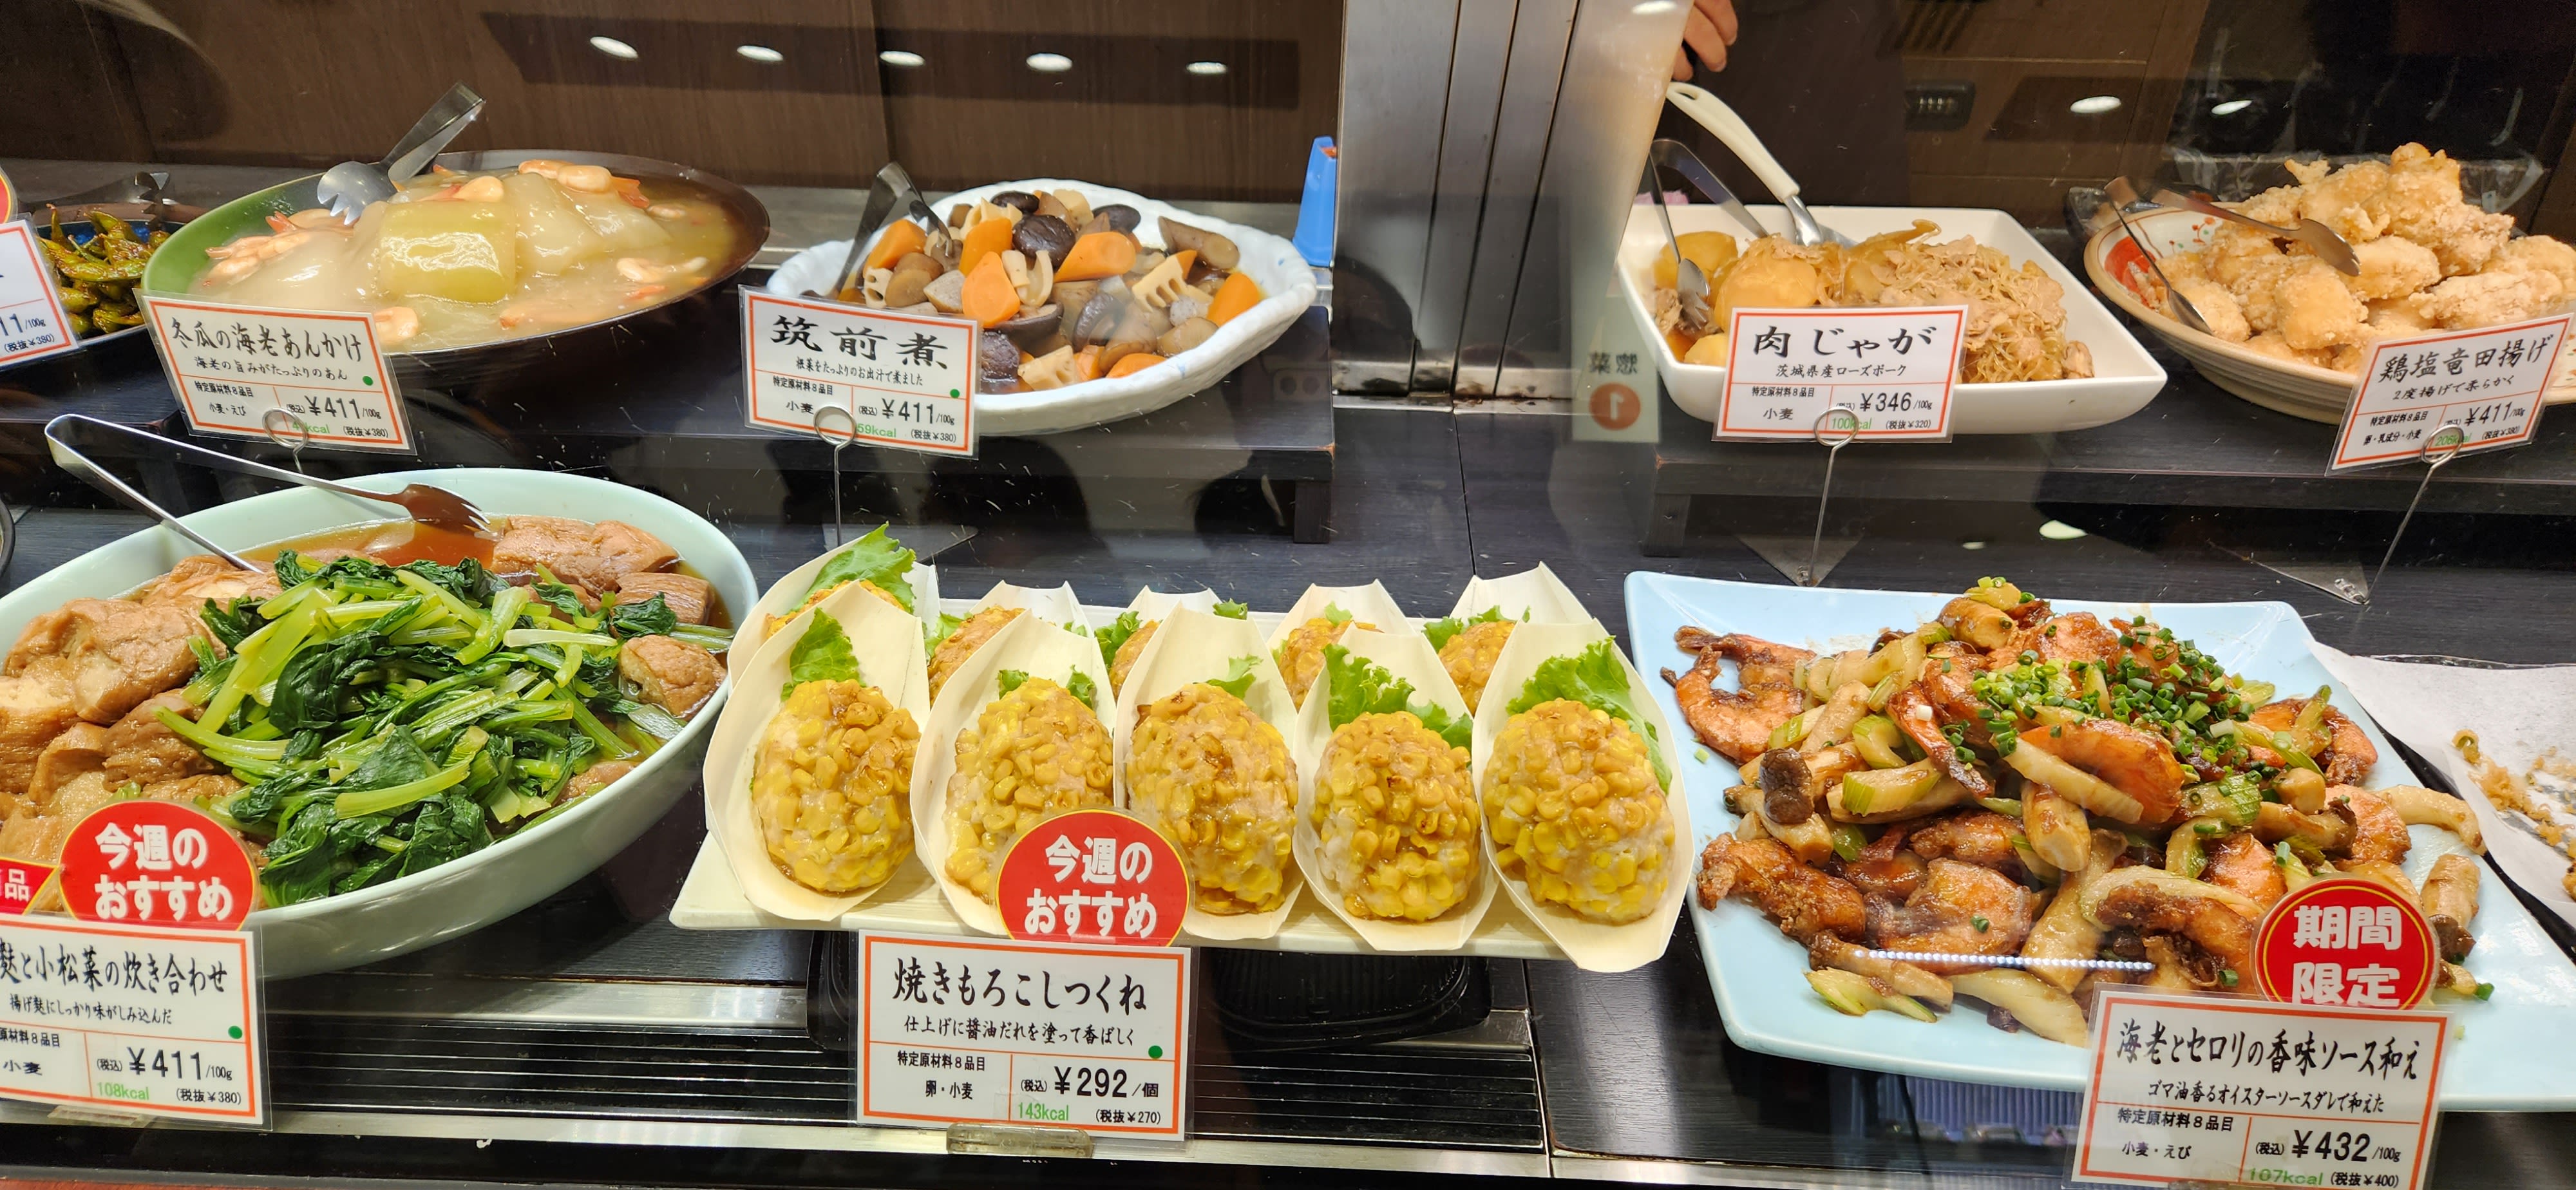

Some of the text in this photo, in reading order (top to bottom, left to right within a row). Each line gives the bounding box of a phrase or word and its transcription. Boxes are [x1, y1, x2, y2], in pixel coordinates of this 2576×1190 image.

[5, 334, 55, 353] (税抜¥380)
[171, 317, 361, 362] 冬瓜の海老あんかけ
[770, 314, 948, 370] 筑前煮
[1753, 325, 1937, 359] 肉じゃが
[194, 356, 347, 381] 海老の旨みがたっぷりのあん
[795, 356, 923, 386] 根菜をたっぷりのお出汁で煮ました
[1776, 363, 1907, 378] 茨城県産ローズポーク
[2378, 334, 2554, 384] 鶏塩竜田揚げ
[773, 375, 833, 395] 特定原材料8品目
[1752, 386, 1815, 397] 特定原材料8品目
[2392, 375, 2514, 401] 2度揚げで柔らかく
[786, 401, 814, 414] 小麦
[1763, 408, 1793, 420] 小麦
[292, 420, 330, 434] 4kcal
[95, 822, 208, 870] 今週の
[1045, 835, 1153, 883] 今週の
[0, 868, 30, 902] 品
[94, 874, 233, 921] おすすめ
[1025, 888, 1157, 939] おすすめ
[2293, 905, 2401, 950] 期間
[893, 956, 1148, 1015] 焼きもろこしつくね
[2292, 962, 2400, 1008] 限定
[904, 1015, 1135, 1046] 仕上げに醤油だれを塗って香ばしく
[897, 1050, 985, 1071] 特定原材料8品目
[2116, 1017, 2420, 1081] 海老とセロリの香味ソース和え
[3, 1060, 43, 1076] 小麦
[97, 1082, 150, 1100] 108kcal
[176, 1087, 242, 1105] (税抜¥380)
[925, 1080, 973, 1100] 卵・小麦
[2148, 1079, 2385, 1114] ゴマ油香るオイスターソースダレで和えた
[1018, 1102, 1070, 1121] 143kcal
[1095, 1108, 1161, 1125] (税抜¥270)
[2117, 1108, 2234, 1131] 特定原材料8品目
[2122, 1141, 2192, 1159] 小麦・えび
[2249, 1167, 2324, 1185] 107kcal
[2331, 1172, 2399, 1188] (税抜¥400)
